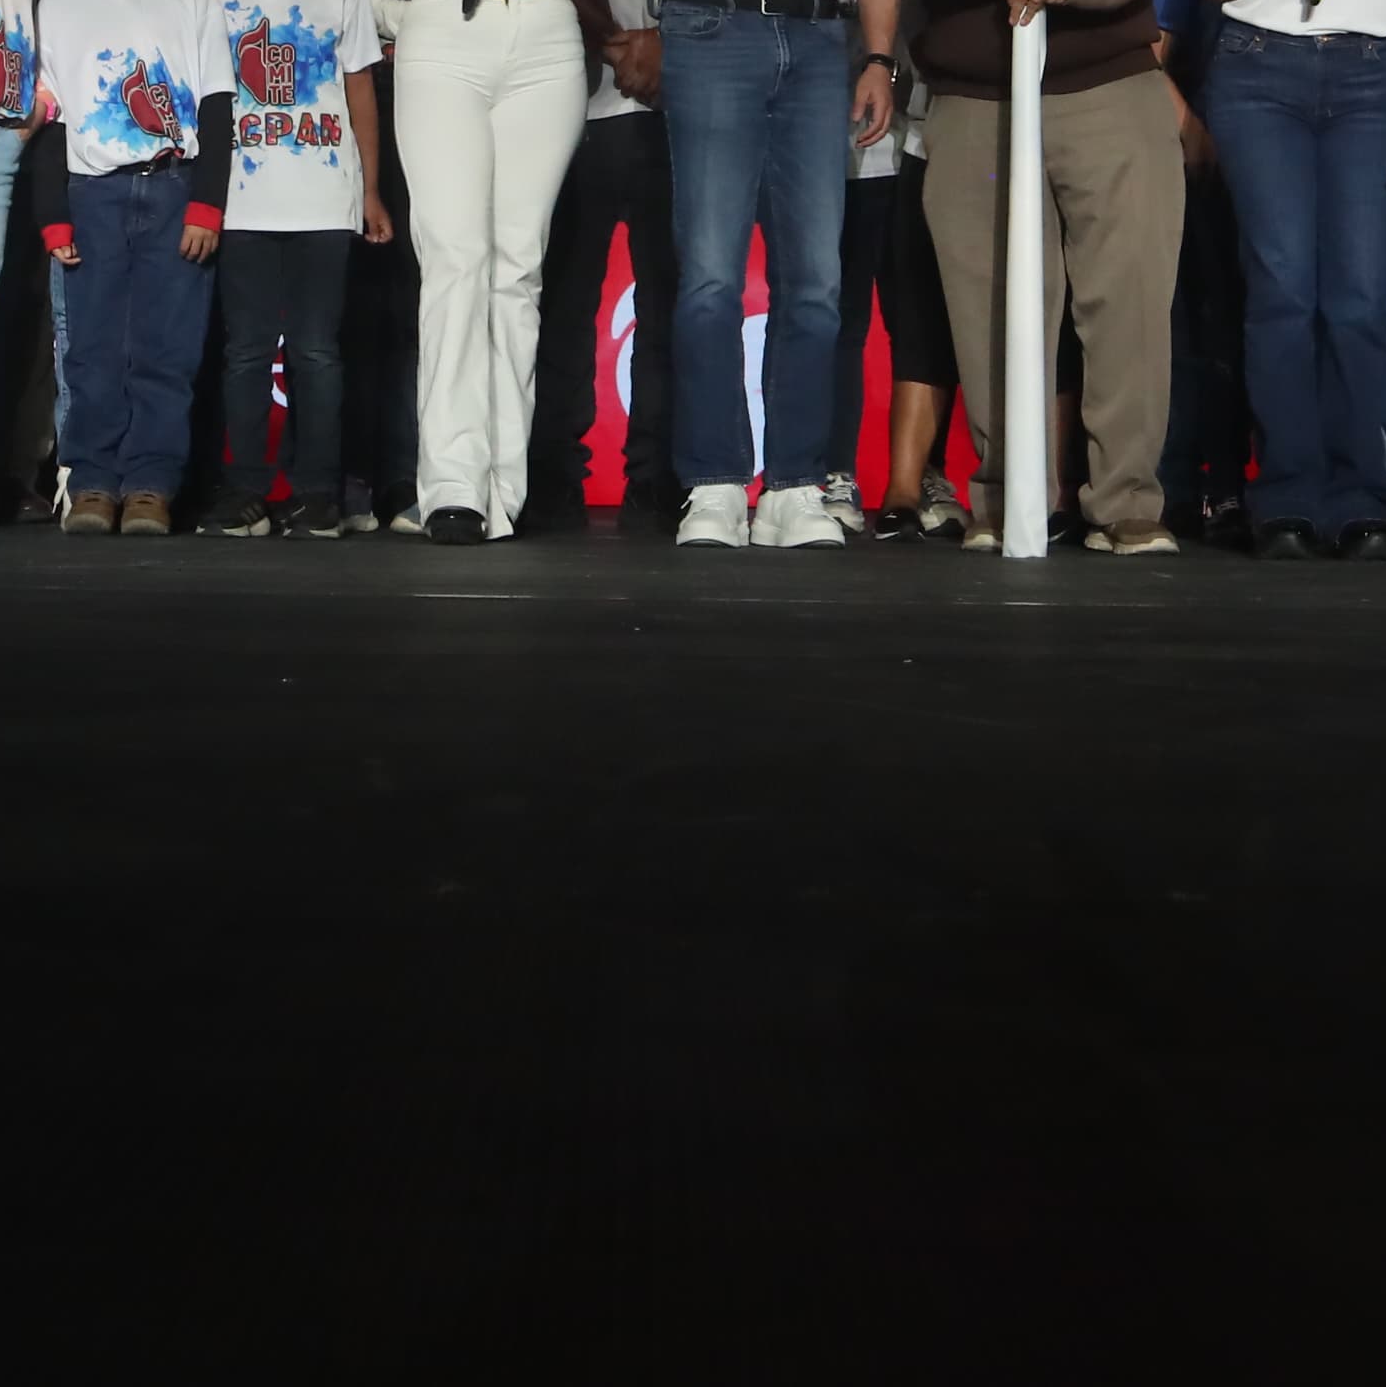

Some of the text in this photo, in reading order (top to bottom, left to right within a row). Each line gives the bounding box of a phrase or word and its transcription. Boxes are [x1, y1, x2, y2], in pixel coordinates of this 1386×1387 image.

[267, 45, 295, 64] CO
[268, 64, 294, 84] MI
[268, 84, 295, 105] TE
